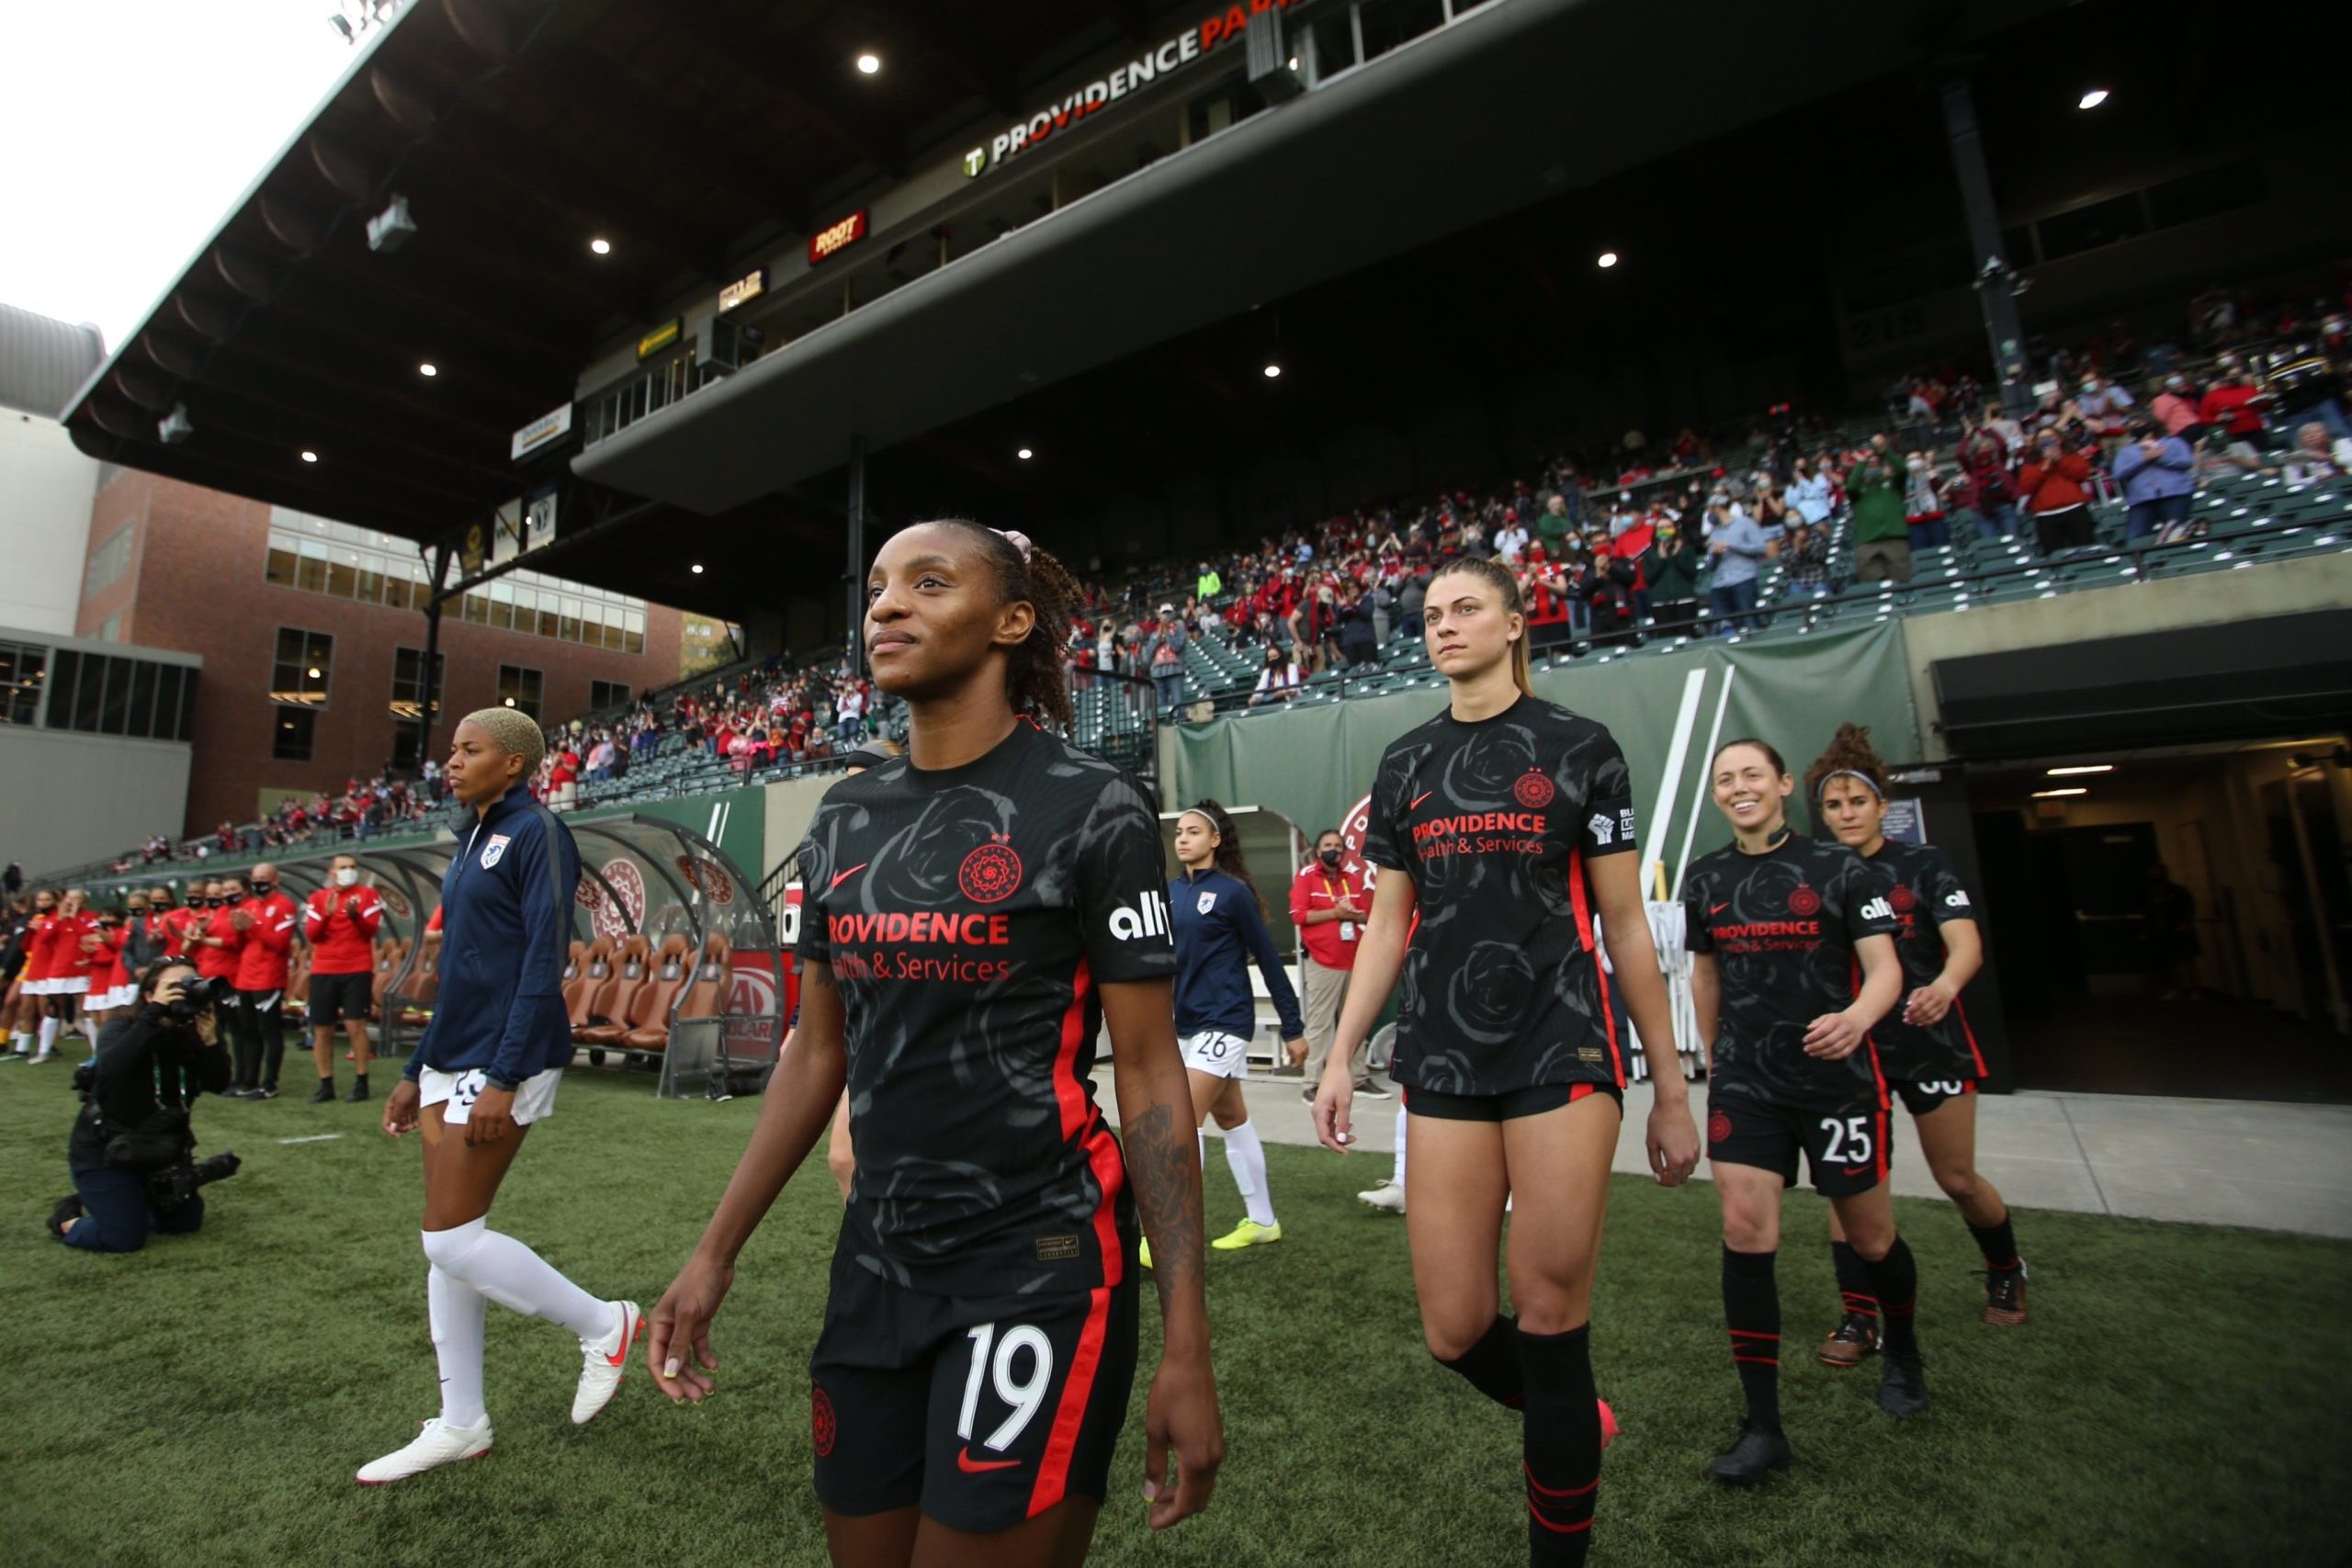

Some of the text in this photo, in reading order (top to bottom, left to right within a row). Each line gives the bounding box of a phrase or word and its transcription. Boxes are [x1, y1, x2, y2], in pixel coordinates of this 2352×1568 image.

[816, 214, 857, 253] ROOT
[1412, 813, 1545, 843] PROVIDENCE
[1457, 838, 1472, 853] &
[1476, 835, 1544, 853] Services
[829, 911, 1009, 945] ROVIDENCE
[873, 952, 893, 979] &
[897, 951, 1011, 983] Services
[1197, 1031, 1227, 1057] 26
[1820, 1117, 1871, 1164] 25
[957, 1323, 1054, 1451] 19
